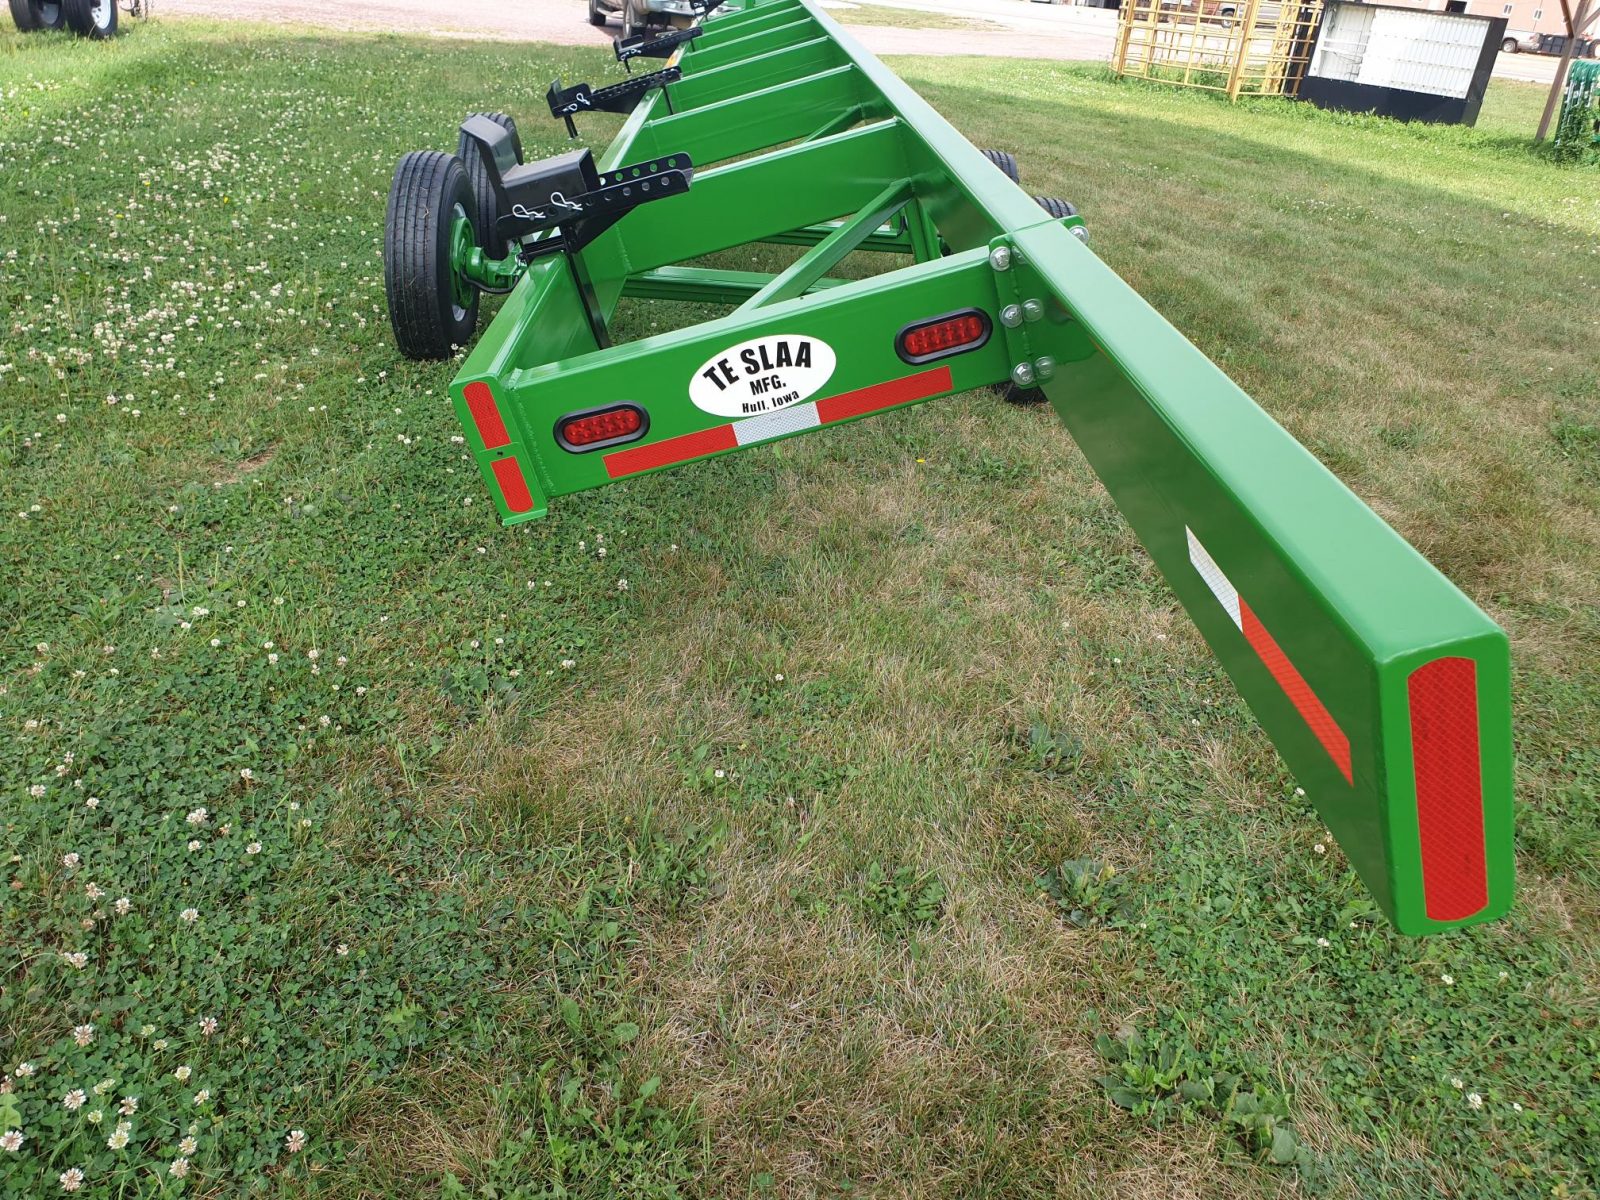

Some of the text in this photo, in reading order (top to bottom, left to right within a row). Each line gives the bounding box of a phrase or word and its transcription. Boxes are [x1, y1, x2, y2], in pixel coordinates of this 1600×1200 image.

[703, 341, 811, 391] TE SLAA
[749, 374, 787, 396] MFG.
[771, 390, 799, 407] Iowa
